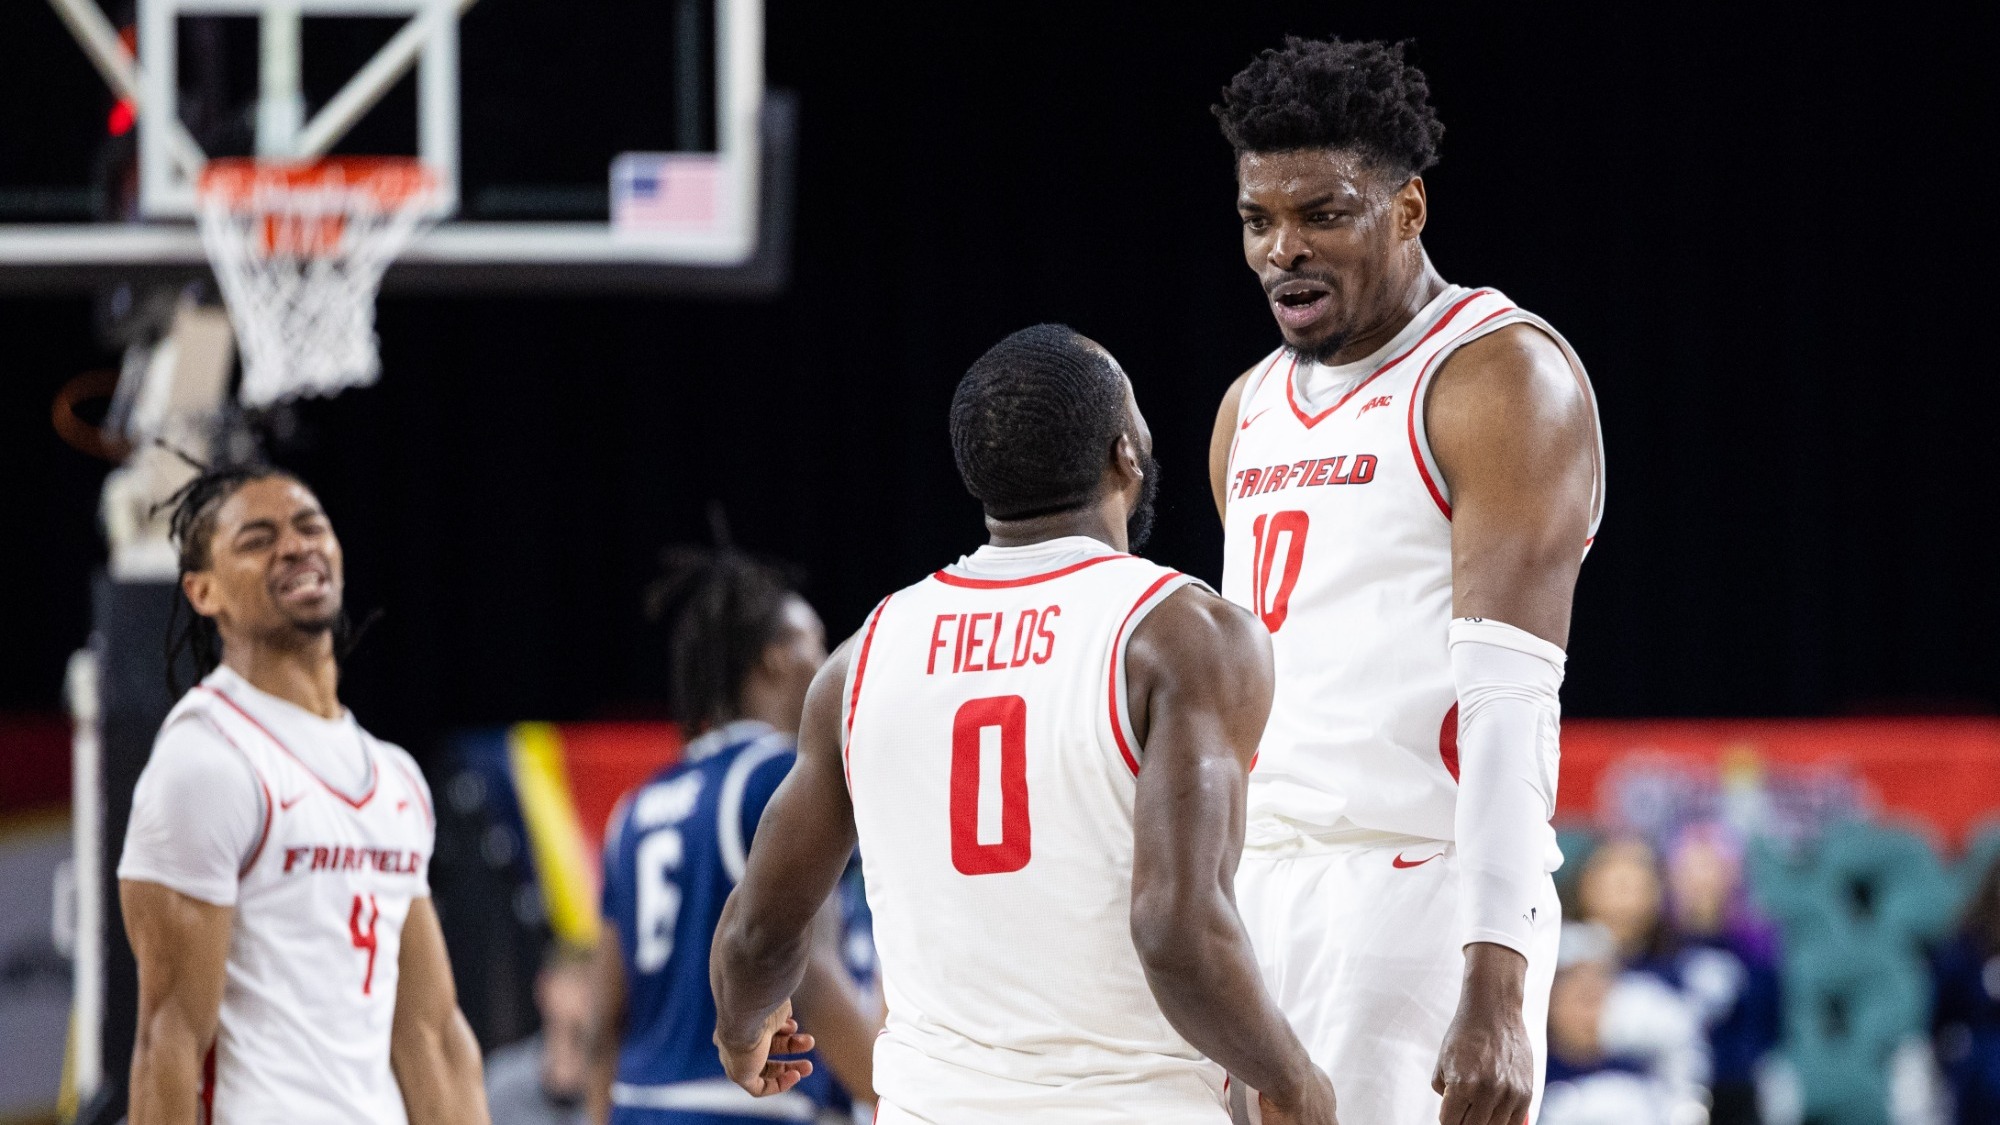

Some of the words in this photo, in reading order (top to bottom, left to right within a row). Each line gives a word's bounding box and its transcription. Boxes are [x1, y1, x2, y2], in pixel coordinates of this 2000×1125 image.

[1229, 453, 1378, 502] FAIRFIELD
[1252, 510, 1310, 634] 10
[926, 605, 1061, 675] FIELDS
[950, 694, 1031, 876] 0
[349, 893, 379, 995] 4
[635, 829, 683, 973] 6
